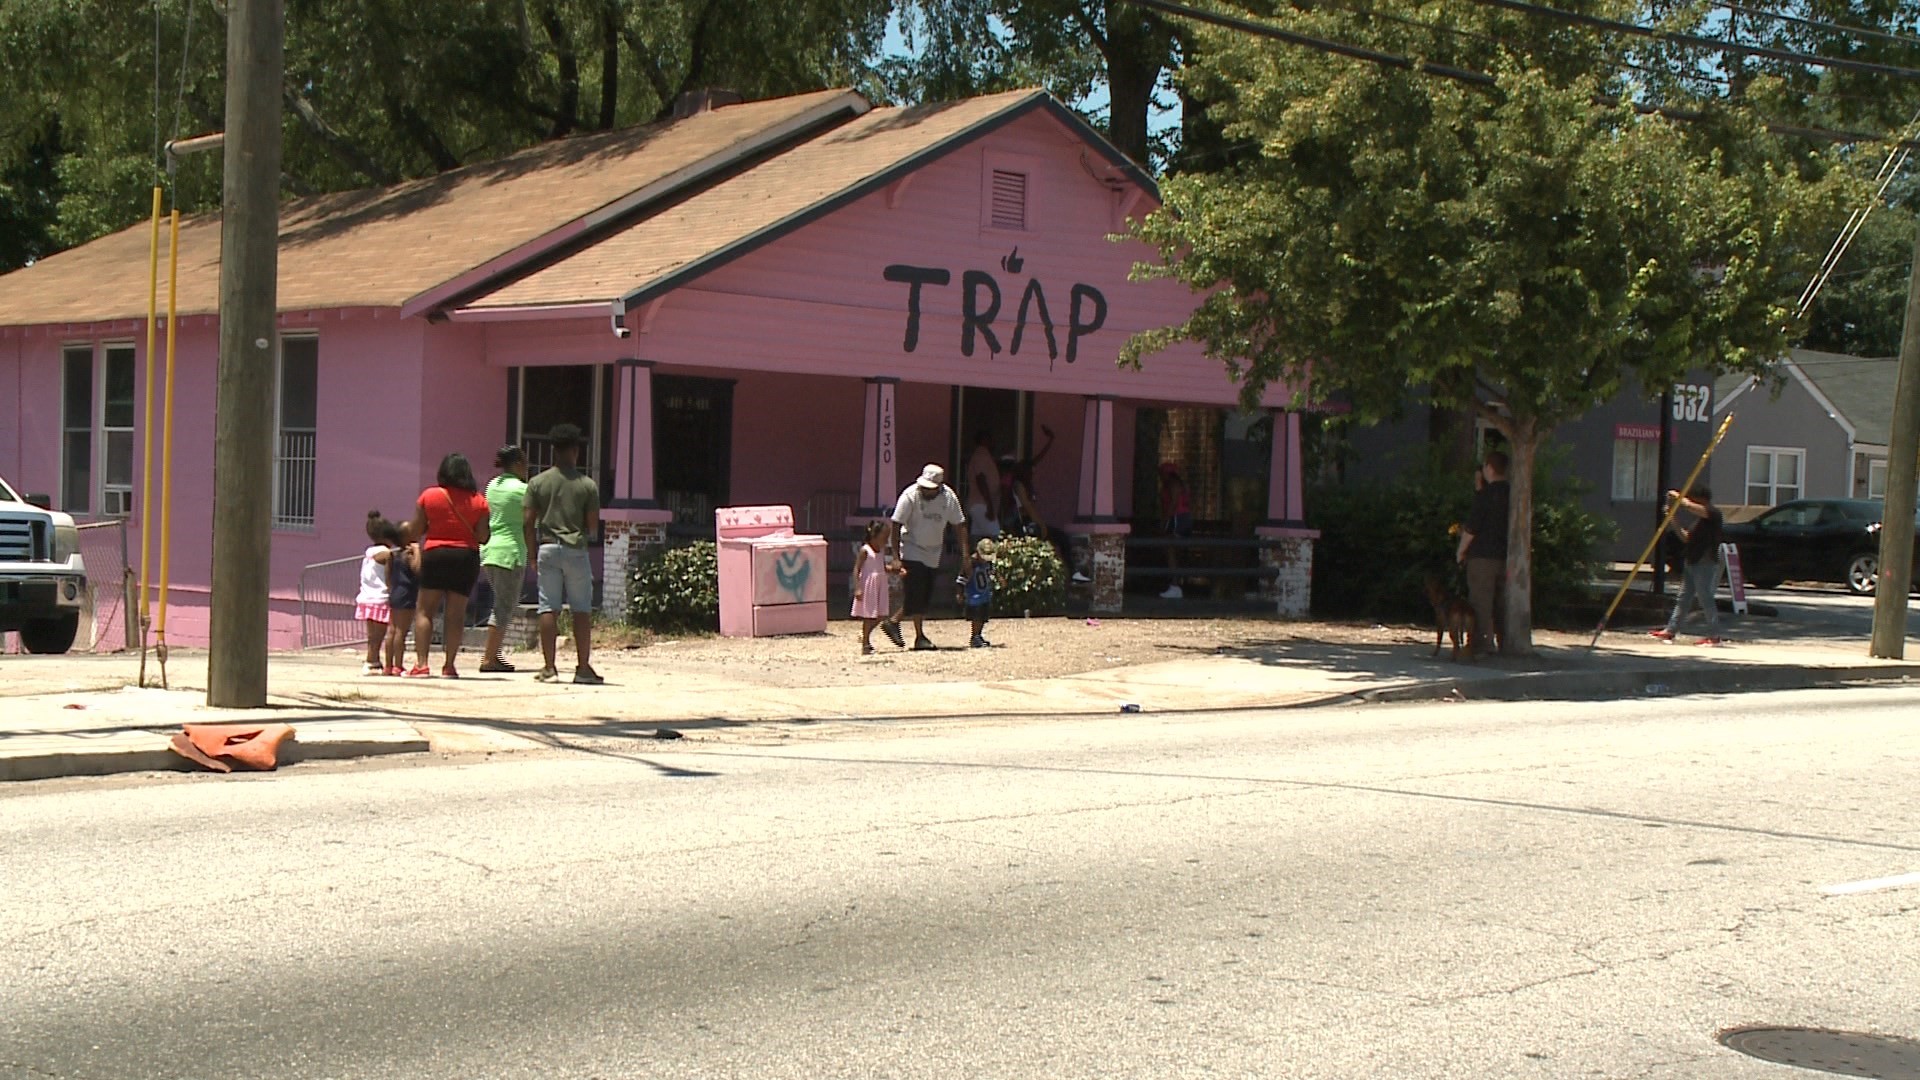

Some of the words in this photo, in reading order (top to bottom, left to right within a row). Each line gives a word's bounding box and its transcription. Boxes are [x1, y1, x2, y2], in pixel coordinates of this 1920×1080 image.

[883, 264, 1107, 365] TRAP
[1673, 384, 1710, 422] 532
[883, 398, 891, 463] 1530
[1619, 427, 1653, 438] BRAZILIAN
